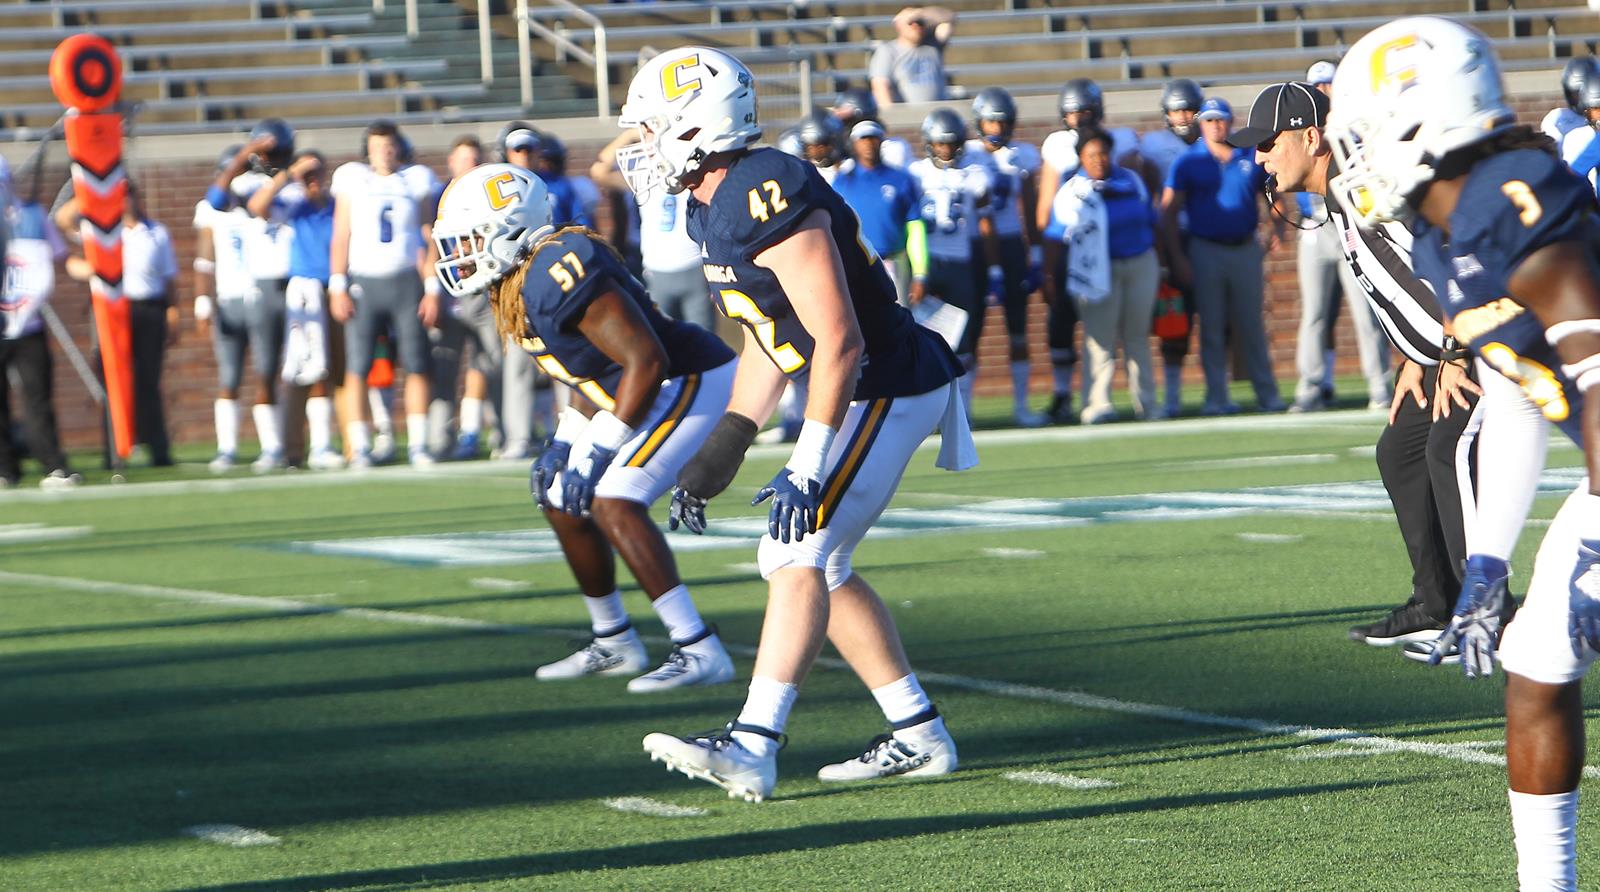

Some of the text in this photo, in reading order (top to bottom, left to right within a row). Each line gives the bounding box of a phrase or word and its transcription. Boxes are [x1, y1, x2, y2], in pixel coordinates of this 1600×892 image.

[660, 53, 702, 102] C
[483, 171, 522, 211] C
[747, 179, 788, 222] 42
[1501, 179, 1543, 228] 3
[548, 251, 585, 292] 57
